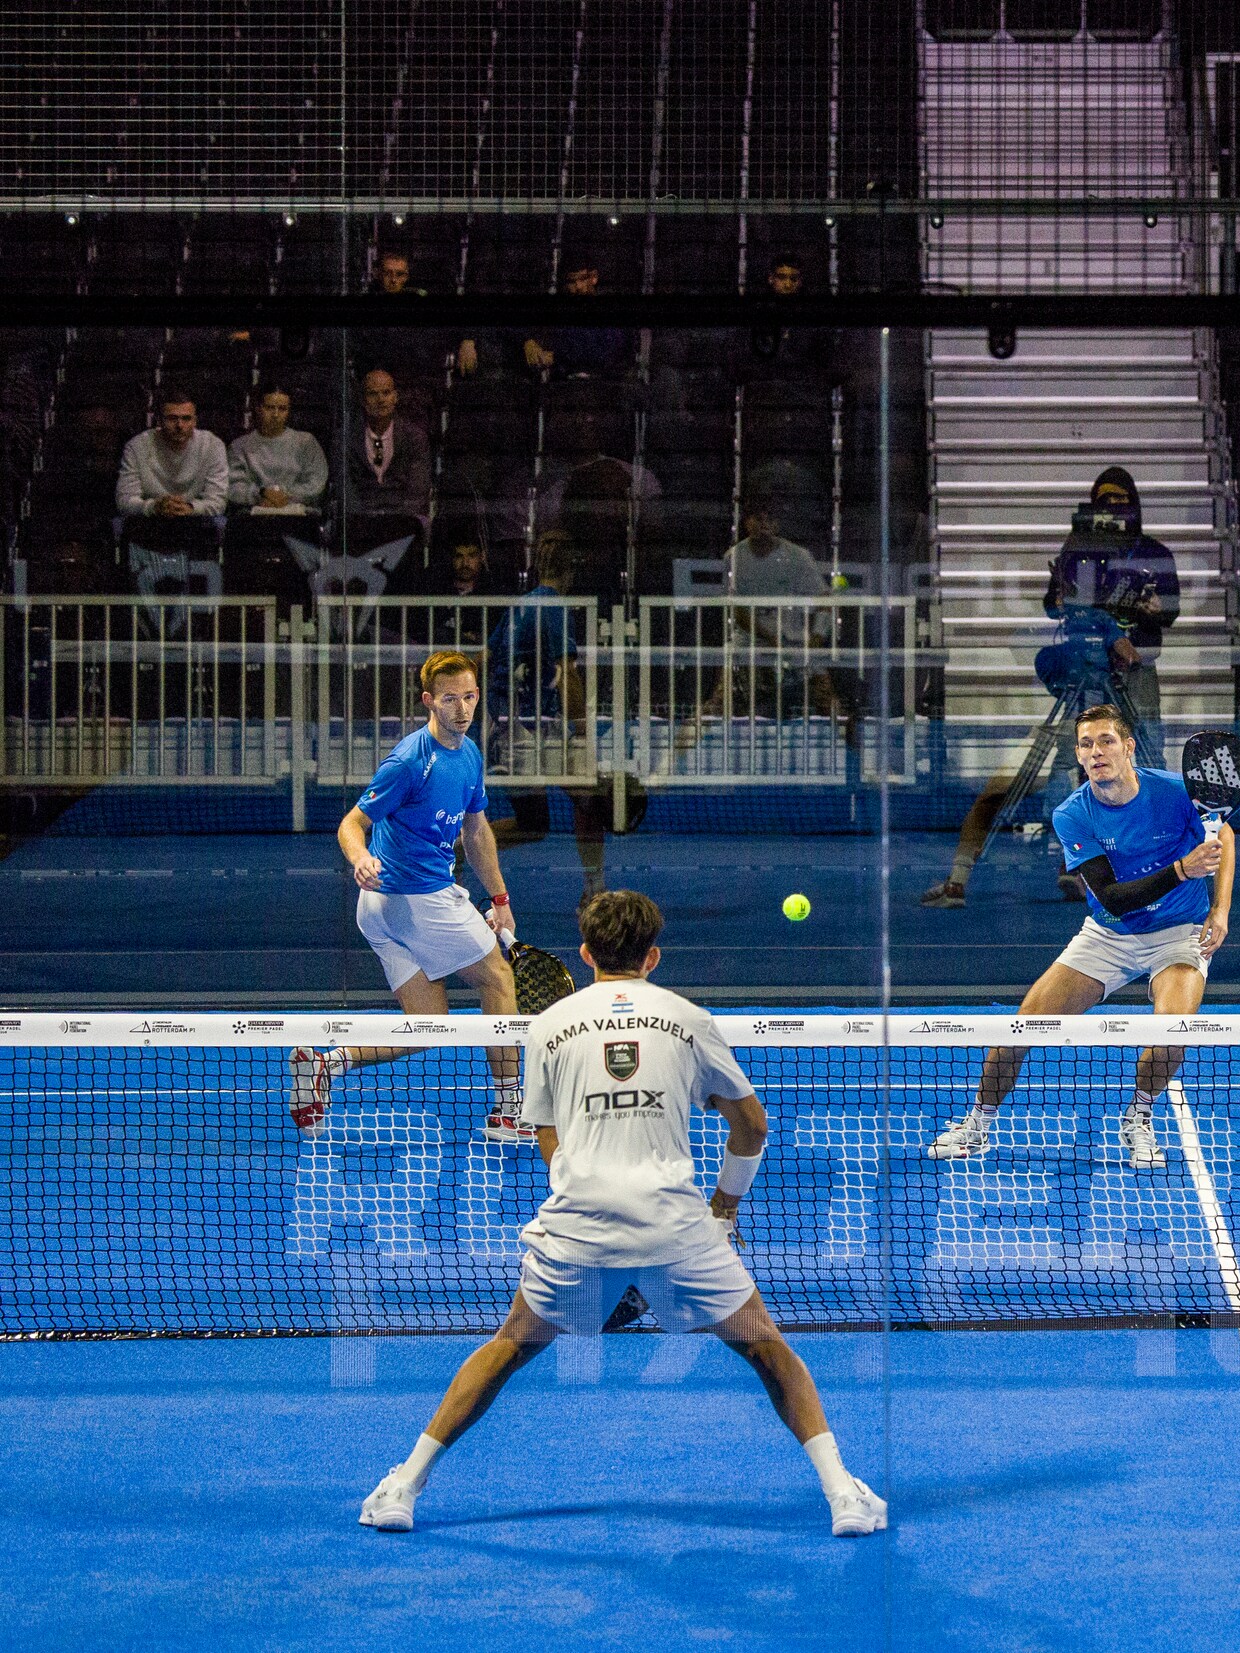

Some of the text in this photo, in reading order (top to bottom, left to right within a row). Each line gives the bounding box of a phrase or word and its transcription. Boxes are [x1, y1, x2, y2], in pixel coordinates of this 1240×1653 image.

[546, 1016, 694, 1055] RAMA VALENZUELA
[614, 1111, 630, 1120] you
